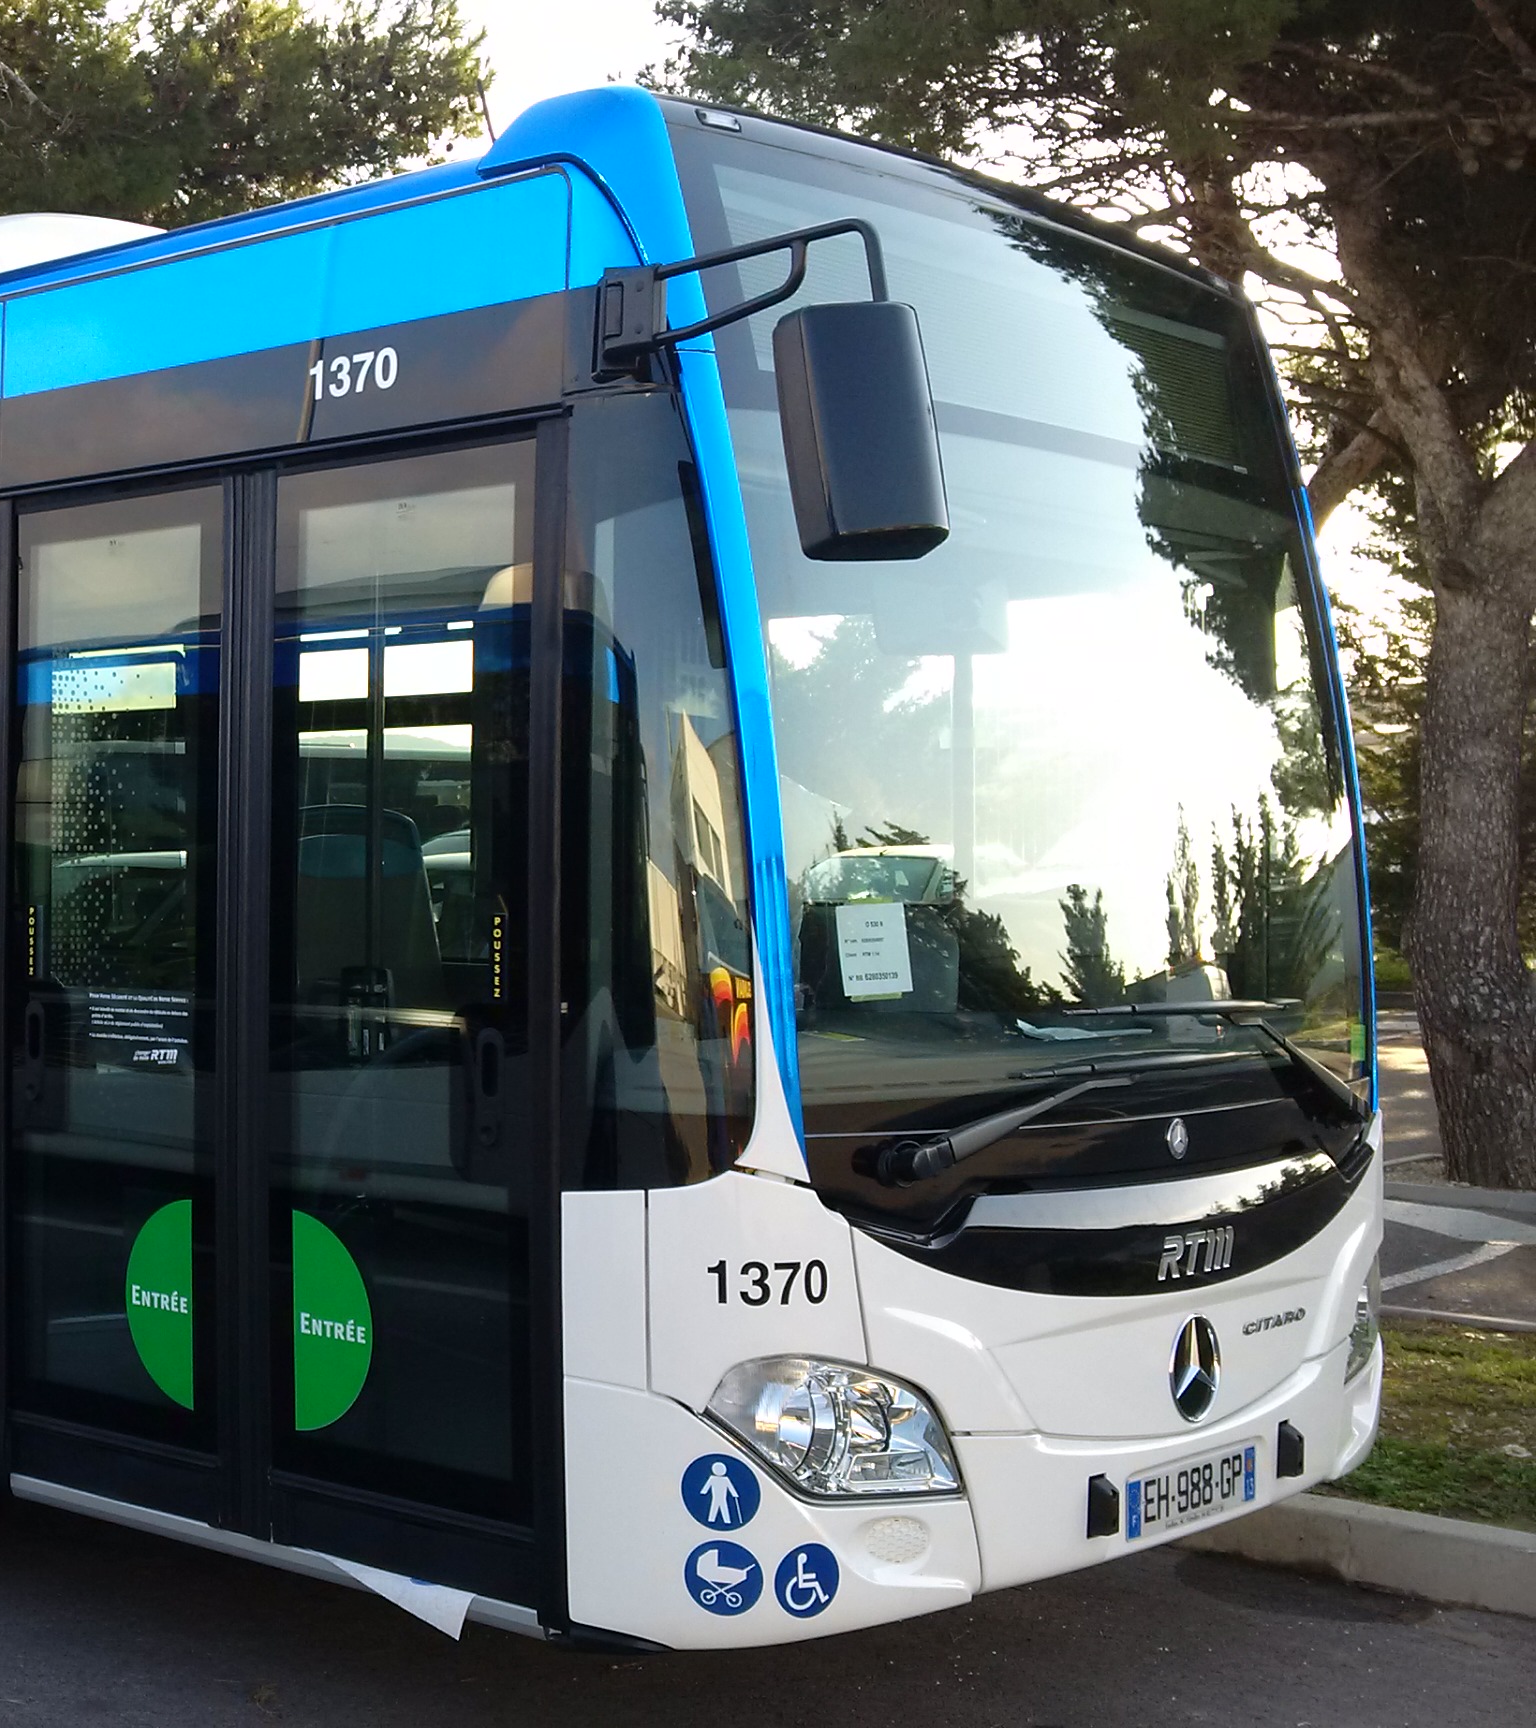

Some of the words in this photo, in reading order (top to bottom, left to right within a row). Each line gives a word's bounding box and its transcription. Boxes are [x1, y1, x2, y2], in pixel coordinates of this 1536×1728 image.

[309, 346, 398, 400] 1370
[492, 916, 502, 998] POUSSEZ
[150, 1049, 178, 1061] RTM
[1157, 1225, 1235, 1282] RTM
[707, 1259, 828, 1306] 1370
[1242, 1307, 1306, 1336] CITARO
[1144, 1453, 1242, 1524] EH-988-GP
